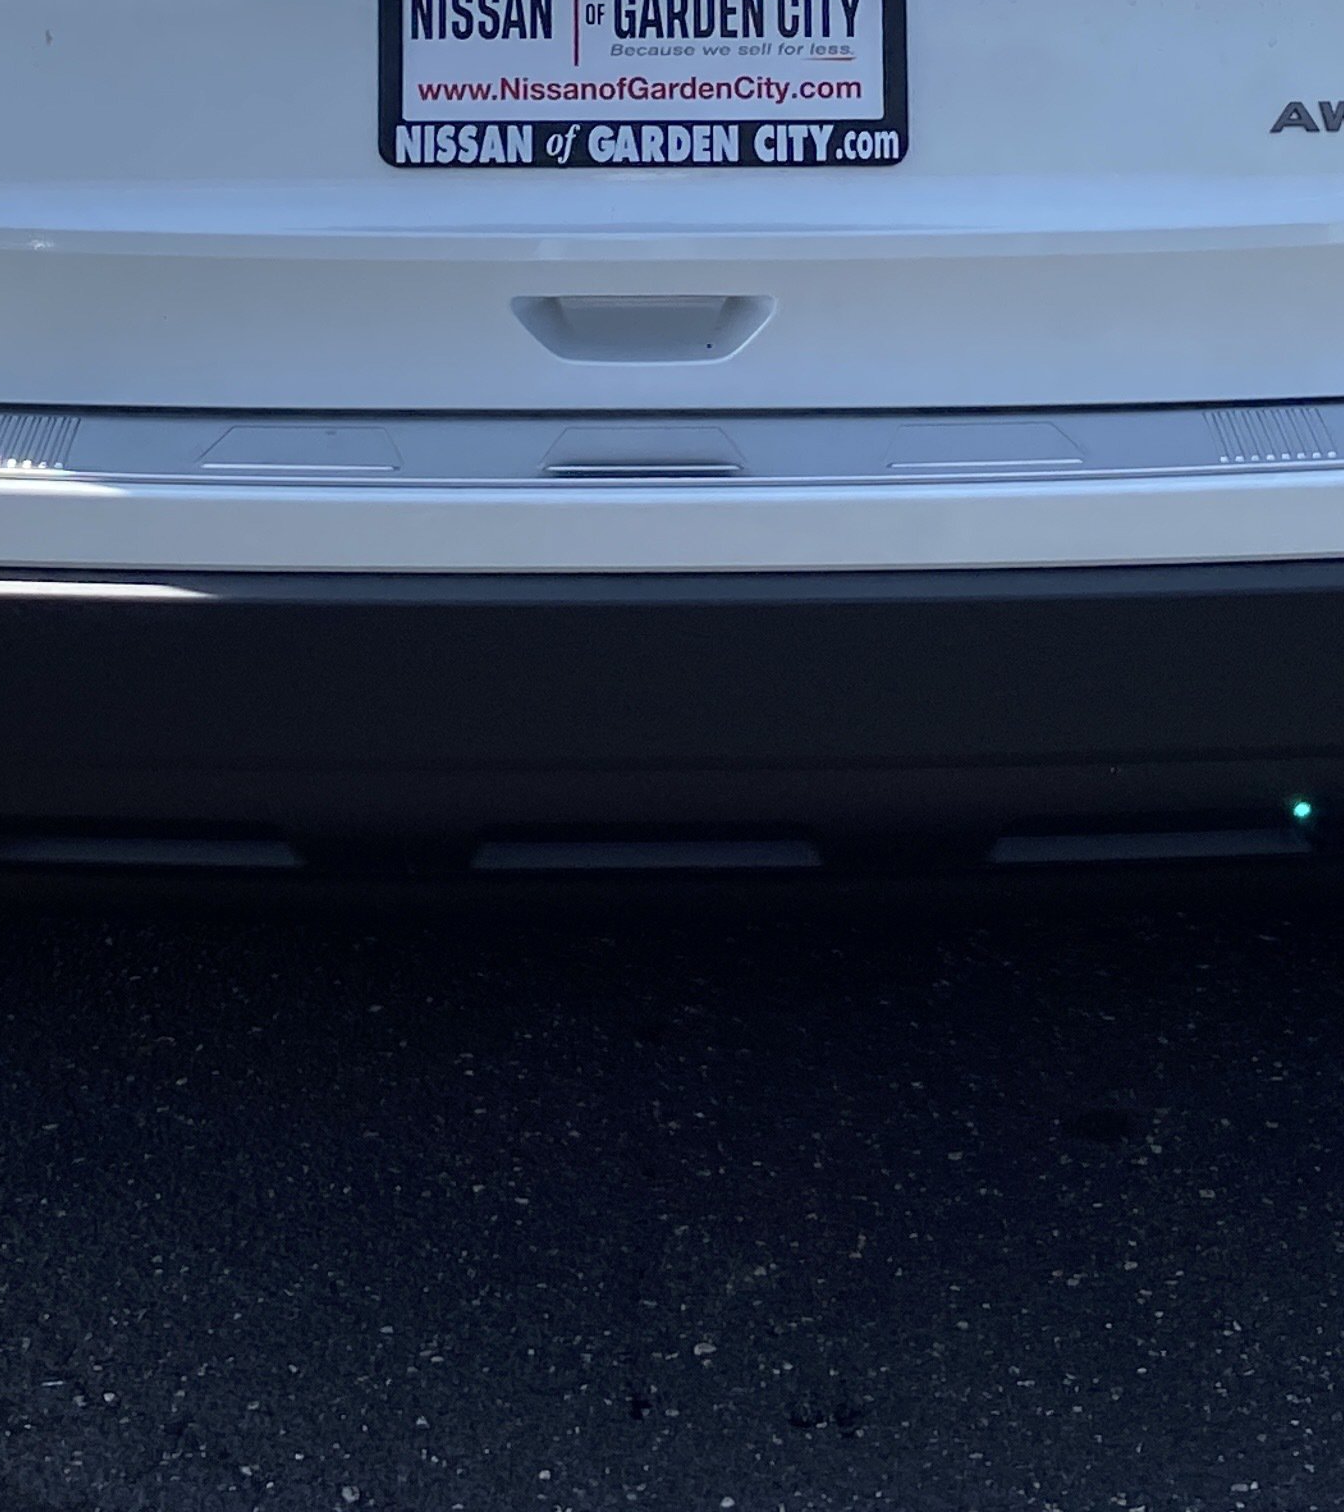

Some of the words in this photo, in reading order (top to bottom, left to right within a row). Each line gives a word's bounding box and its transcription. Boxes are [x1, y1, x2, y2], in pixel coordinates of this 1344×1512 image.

[585, 3, 605, 25] OF
[610, 43, 696, 57] Because
[702, 45, 732, 56] we
[738, 43, 773, 56] sell
[777, 43, 805, 56] for
[809, 43, 855, 56] less.
[418, 76, 863, 104] www.NissanofGardenCity.com
[395, 124, 533, 163] NISSAN
[546, 124, 580, 164] of
[588, 124, 739, 163] GARDEN
[754, 124, 899, 162] CITY.com
